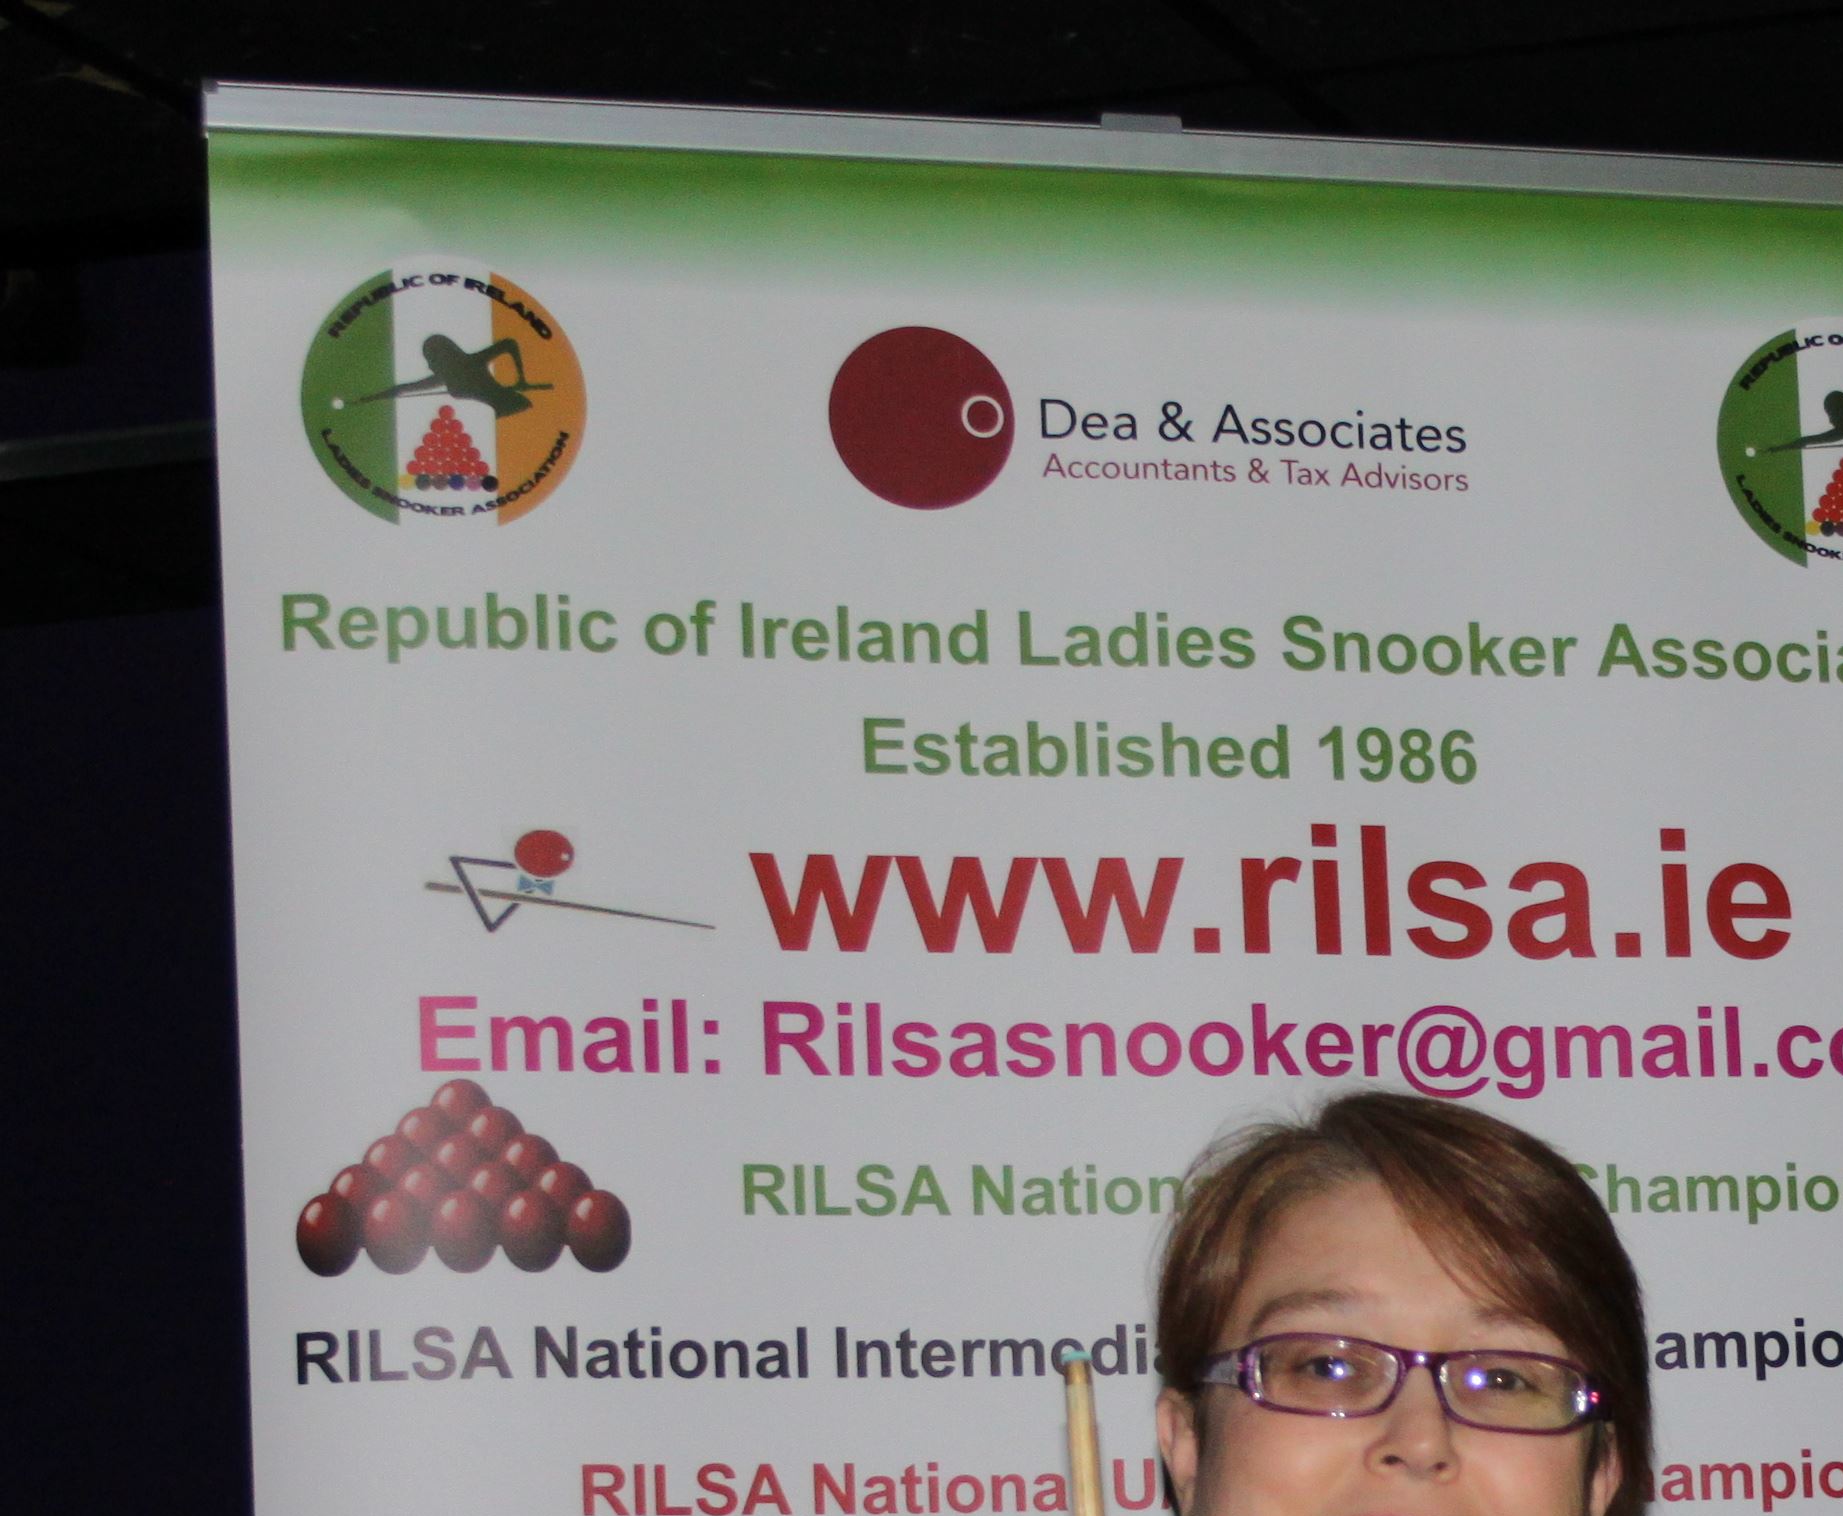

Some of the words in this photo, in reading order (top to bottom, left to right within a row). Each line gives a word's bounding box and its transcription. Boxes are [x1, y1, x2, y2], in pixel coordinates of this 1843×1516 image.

[328, 274, 424, 338] REPUBLIC
[430, 273, 459, 287] OF
[464, 277, 553, 339] IRELAND
[1740, 335, 1824, 391] REPUBLIC
[1041, 399, 1138, 442] Dea
[1159, 401, 1196, 443] &
[1213, 405, 1467, 454] Associates
[321, 428, 372, 490] LADIES
[371, 486, 465, 516] SNOOKER
[472, 431, 570, 515] ASSOCIATION
[1044, 454, 1237, 483] Accountants
[1249, 459, 1270, 484] &
[1281, 460, 1331, 486] Tax
[1342, 463, 1469, 492] Advisors
[1736, 474, 1781, 533] LADIES
[282, 593, 618, 664] Republic
[645, 600, 717, 657] of
[742, 603, 989, 666] Ireland
[1019, 611, 1257, 670] Ladies
[1283, 616, 1579, 678] Snooker
[864, 718, 1291, 780] Established
[1320, 727, 1478, 786] 1986
[749, 824, 1793, 961] www.rilsa.ie
[420, 997, 721, 1073] Email:
[743, 1165, 951, 1217] RILSA
[973, 1164, 1212, 1217] Nation
[296, 1327, 514, 1387] RILSA
[535, 1327, 809, 1380] National
[814, 1463, 1067, 1516] Nationa
